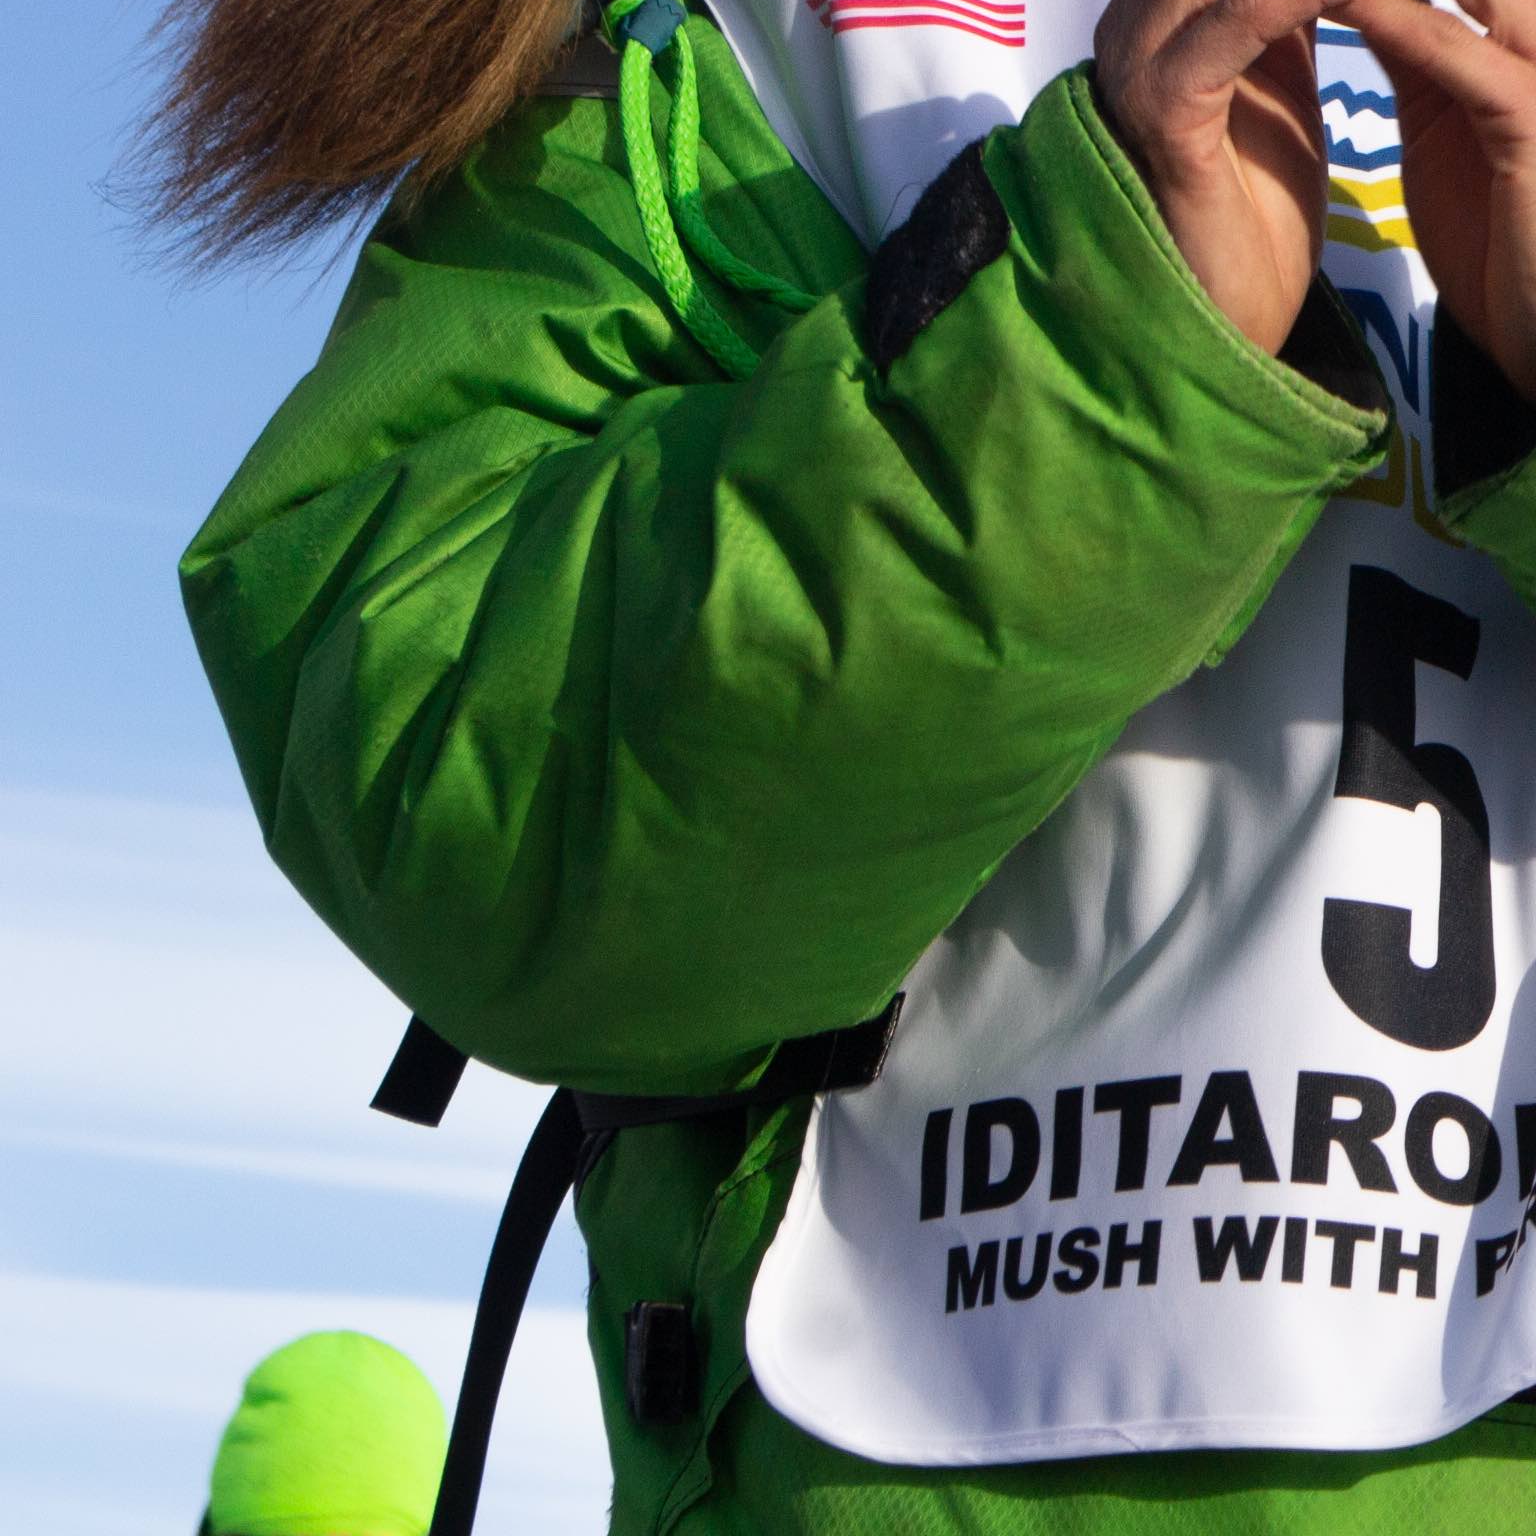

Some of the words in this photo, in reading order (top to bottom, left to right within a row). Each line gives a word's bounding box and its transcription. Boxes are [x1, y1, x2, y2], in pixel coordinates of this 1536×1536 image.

[1321, 563, 1496, 1052] 5
[943, 1219, 1164, 1314] MUSH
[1192, 1215, 1439, 1298] WITH
